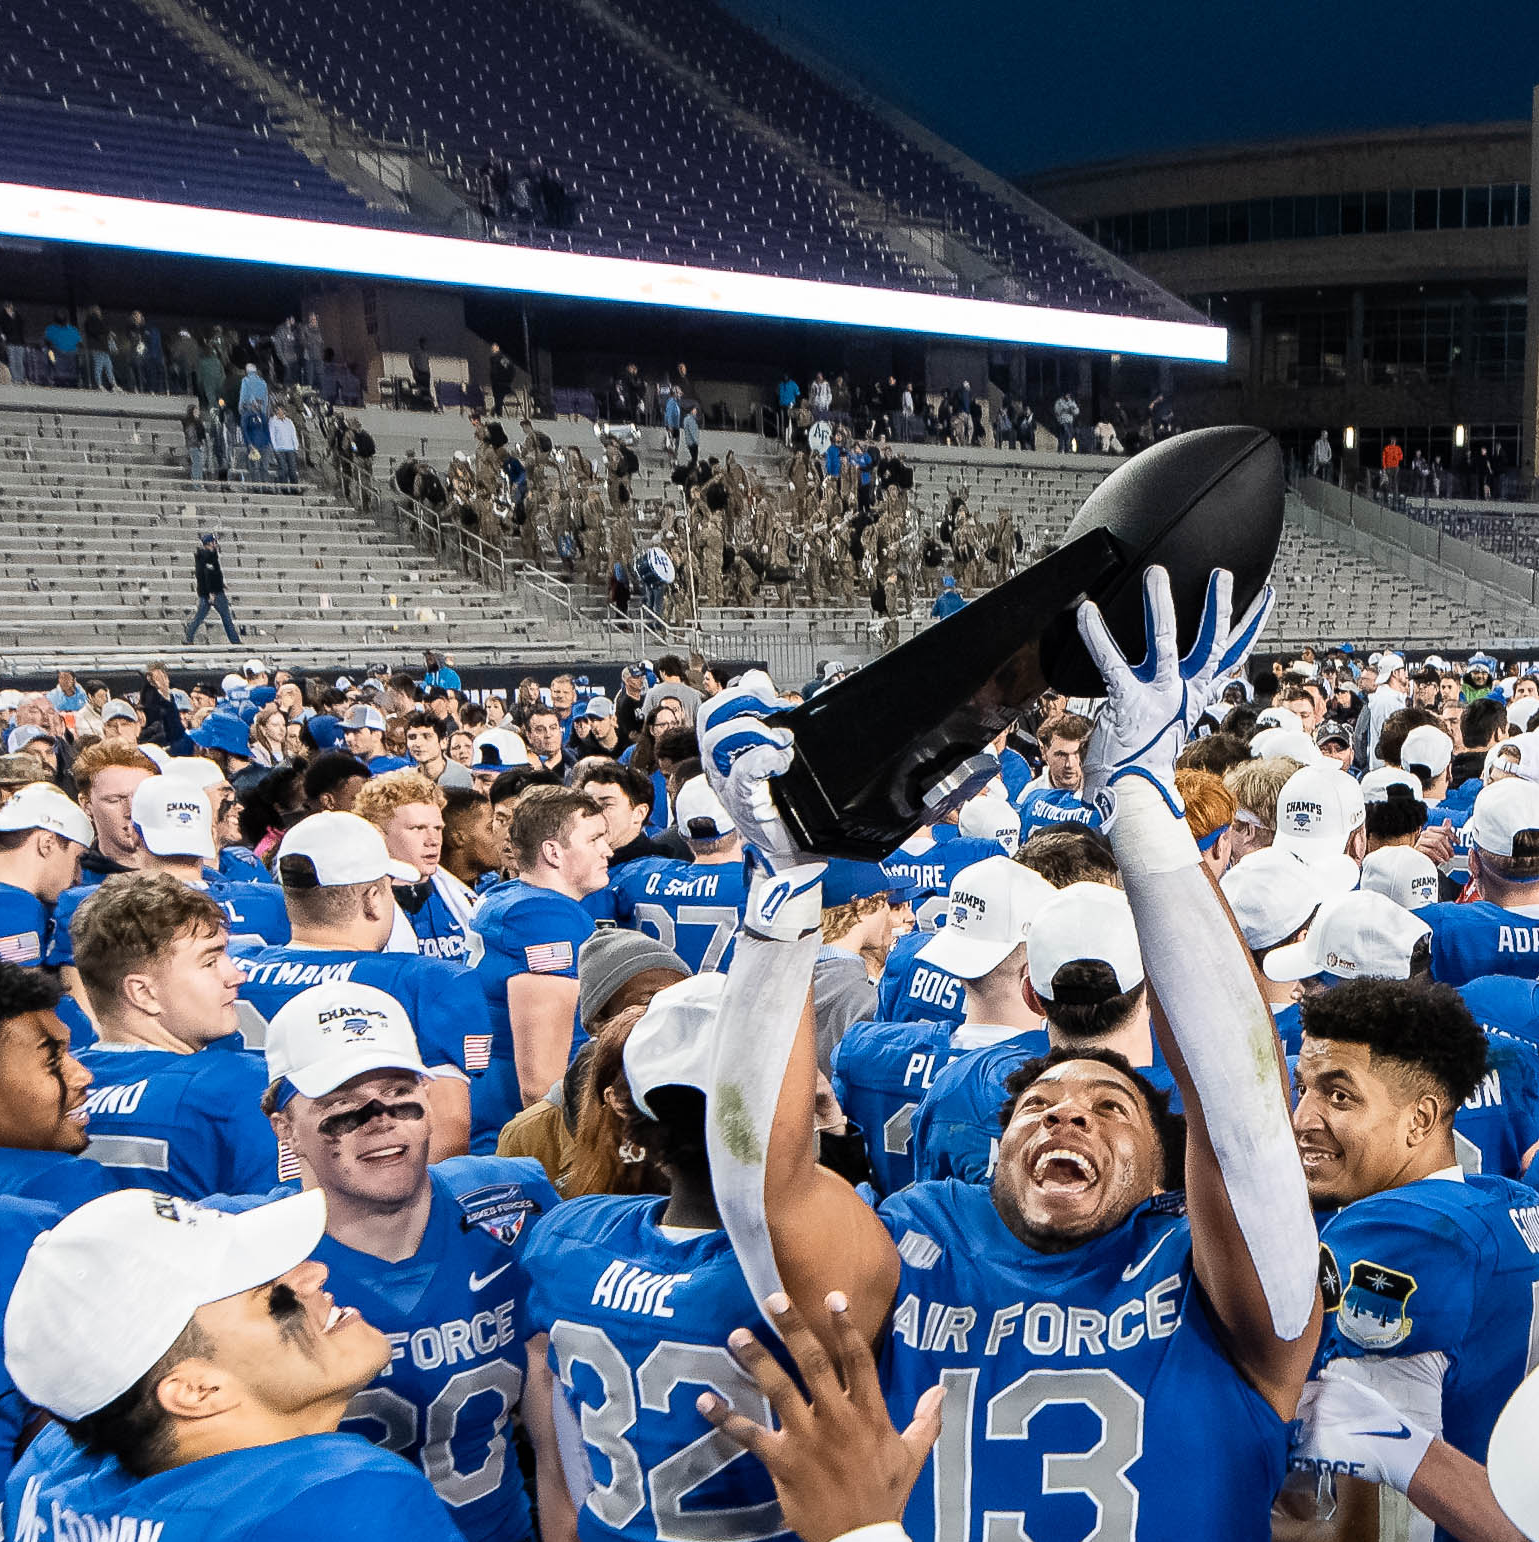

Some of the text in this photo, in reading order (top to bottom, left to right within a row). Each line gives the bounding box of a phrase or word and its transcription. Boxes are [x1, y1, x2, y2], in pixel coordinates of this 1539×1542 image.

[1285, 800, 1324, 817] CHAMPS
[663, 874, 720, 897] SMITH
[1411, 875, 1438, 891] CHAMP
[417, 938, 466, 959] FORC
[909, 966, 962, 1010] BOIS
[82, 1078, 149, 1115] AND
[591, 1258, 691, 1320] AIHIE
[891, 1273, 1183, 1358] AIR FORCE
